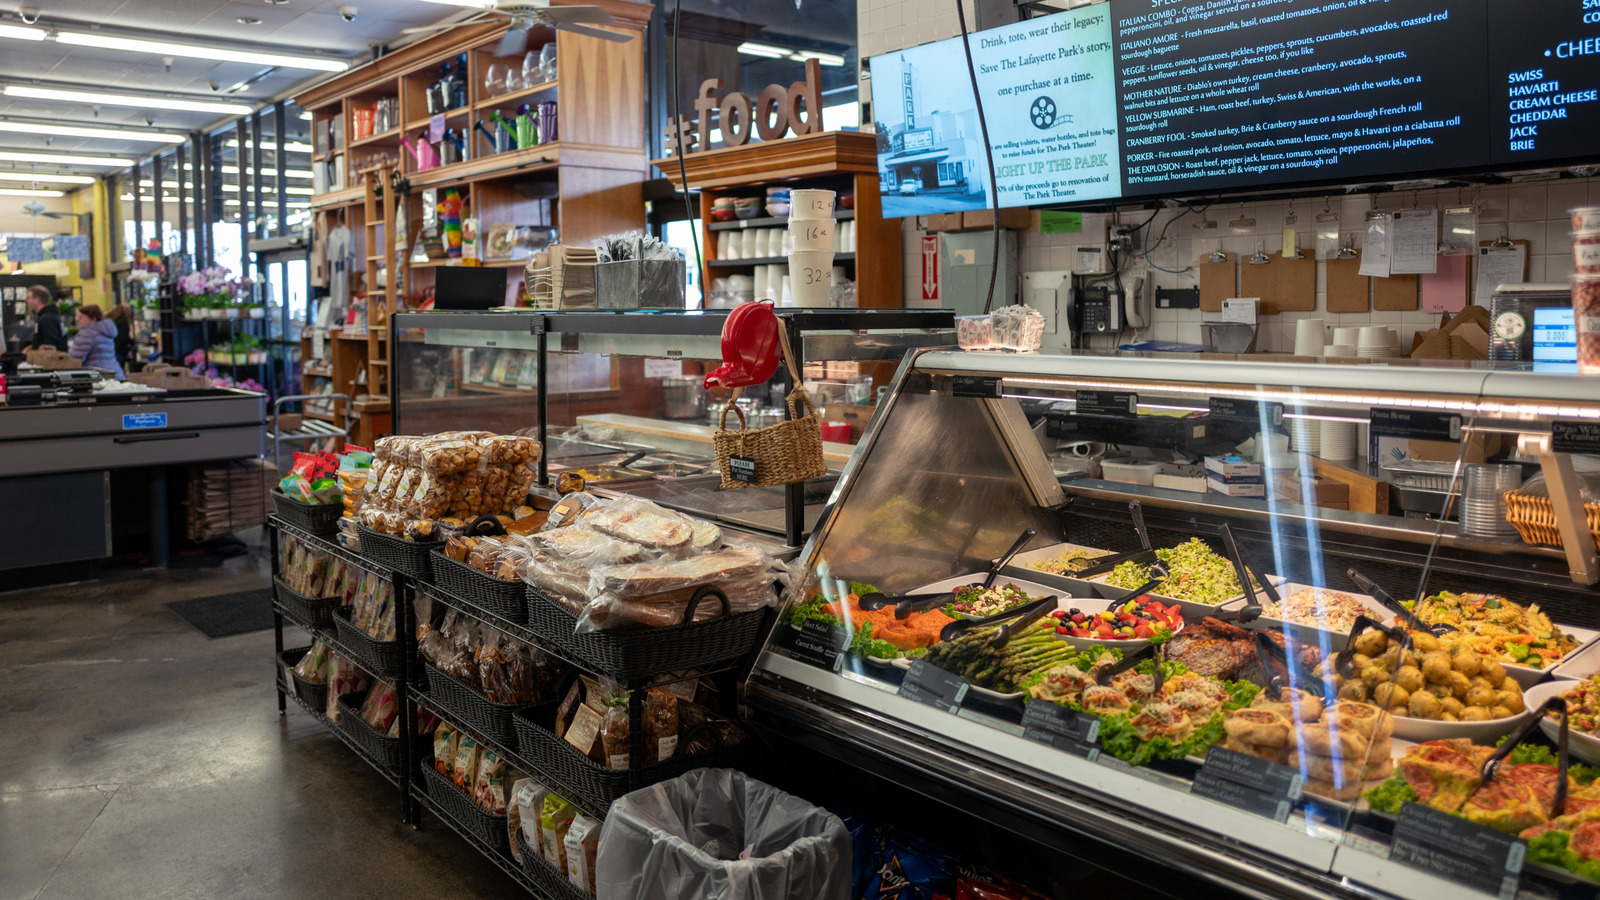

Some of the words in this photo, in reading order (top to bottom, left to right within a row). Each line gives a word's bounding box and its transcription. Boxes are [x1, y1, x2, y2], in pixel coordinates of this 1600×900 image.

[1120, 14, 1146, 28] ITALIAN
[1148, 8, 1176, 22] COMBO
[1207, 0, 1231, 10] Danish
[981, 34, 1006, 49] Drink,
[1009, 32, 1026, 43] tote,
[1029, 27, 1048, 39] wear
[1051, 21, 1071, 34] their
[1073, 14, 1103, 30] legacy:
[1120, 20, 1162, 37] pepperoncini,
[1121, 37, 1151, 51] ITALIANO
[1152, 32, 1178, 45] AMORE
[1203, 21, 1239, 35] mozzarella,
[1259, 11, 1285, 24] roasted
[1286, 7, 1321, 19] tomatoes,
[1122, 65, 1145, 76] VEGGIE
[1151, 62, 1174, 71] Lettuce,
[1175, 58, 1197, 67] onions,
[1198, 52, 1230, 63] tomatoes,
[1231, 46, 1255, 60] pickles,
[1256, 42, 1285, 55] peppers,
[1287, 36, 1315, 49] sprouts,
[1316, 28, 1359, 42] cucumbers,
[1360, 21, 1399, 35] avocados,
[1401, 13, 1431, 27] roasted
[980, 63, 998, 75] Save
[1000, 58, 1016, 71] The
[1019, 51, 1056, 67] Lafayette
[1058, 45, 1084, 59] Park's
[1087, 43, 1111, 54] story,
[1121, 47, 1152, 60] sourdough
[1123, 76, 1147, 88] peppers,
[1148, 71, 1178, 81] sunflower
[1214, 60, 1240, 70] vinegar,
[1241, 56, 1264, 66] cheese
[1124, 88, 1153, 101] MOTHER
[1154, 84, 1182, 96] NATURE
[1187, 79, 1212, 91] Diablo's
[1229, 74, 1251, 84] turkey,
[1275, 68, 1300, 77] cheese,
[1301, 61, 1338, 73] cranberry,
[1340, 54, 1373, 67] avocado,
[1375, 50, 1407, 63] sprouts,
[1508, 69, 1544, 83] SWISS
[998, 87, 1012, 96] one
[1014, 79, 1051, 96] purchase
[1053, 76, 1061, 86] at
[1064, 77, 1069, 85] a
[1071, 73, 1093, 83] time.
[1509, 81, 1559, 97] HAVARTI
[904, 74, 914, 127] PARK
[1124, 100, 1144, 110] walnut
[1169, 95, 1190, 104] lettuce
[1125, 112, 1152, 124] YELLOW
[1153, 106, 1194, 120] SUBMARINE
[1252, 95, 1276, 106] turkey,
[1305, 87, 1341, 98] American,
[1509, 96, 1550, 110] CREAM
[1553, 90, 1598, 105] CHEESE
[1510, 108, 1567, 124] CHEDDAR
[1126, 135, 1165, 147] CRANBERRY
[1167, 132, 1186, 142] FOOL
[1191, 128, 1216, 139] Smoked
[1218, 126, 1240, 136] turkey,
[1262, 120, 1297, 130] Cranberry
[1337, 107, 1378, 121] sourdough
[1380, 104, 1406, 116] French
[1126, 120, 1157, 133] sourdough
[1510, 126, 1538, 139] JACK
[1003, 141, 1019, 149] selling
[1020, 138, 1040, 147] t-shirts,
[1041, 136, 1056, 144] water
[1057, 133, 1077, 142] bottles,
[1102, 128, 1115, 137] bags
[1127, 151, 1154, 162] PORKER
[1171, 147, 1193, 157] roasted
[1246, 138, 1275, 149] avocado,
[1276, 136, 1303, 145] tomato,
[1304, 133, 1330, 142] lettuce,
[1362, 125, 1390, 136] Havarti
[1411, 119, 1444, 130] ciabatta
[1510, 140, 1535, 151] BRIE
[1021, 147, 1036, 156] funds
[1046, 145, 1057, 153] The
[1058, 142, 1071, 151] Park
[1072, 139, 1096, 149] Theater!
[1128, 166, 1141, 175] THE
[1142, 162, 1180, 174] EXPLOSION
[1221, 157, 1243, 168] pepper
[1261, 153, 1285, 161] lettuce,
[1339, 140, 1391, 156] pepperoncini,
[1393, 136, 1433, 150] jalapeños,
[995, 165, 1026, 178] IGHT
[1029, 162, 1044, 175] UP
[1046, 158, 1071, 172] THE
[1074, 153, 1108, 169] PARK
[1144, 172, 1170, 183] mustard,
[1171, 168, 1206, 180] horseradish
[1244, 164, 1269, 174] vinegar
[1286, 156, 1324, 168] sourdough
[1025, 180, 1050, 192] proceeds
[1068, 176, 1101, 186] renovation
[1023, 192, 1035, 200] The
[1036, 190, 1050, 199] Park
[1051, 189, 1076, 197] Theater.
[811, 200, 824, 210] 12
[807, 227, 818, 240] 16
[925, 243, 934, 251] FIRE
[803, 268, 821, 284] 32
[1372, 410, 1389, 418] Pasta
[804, 620, 815, 628] Beet
[815, 624, 828, 632] Salad
[796, 639, 810, 648] Carrot
[1026, 709, 1044, 719] Carrot
[1026, 726, 1054, 741] Eggplant
[1210, 748, 1231, 759] Greek
[1207, 757, 1231, 769] Lemon
